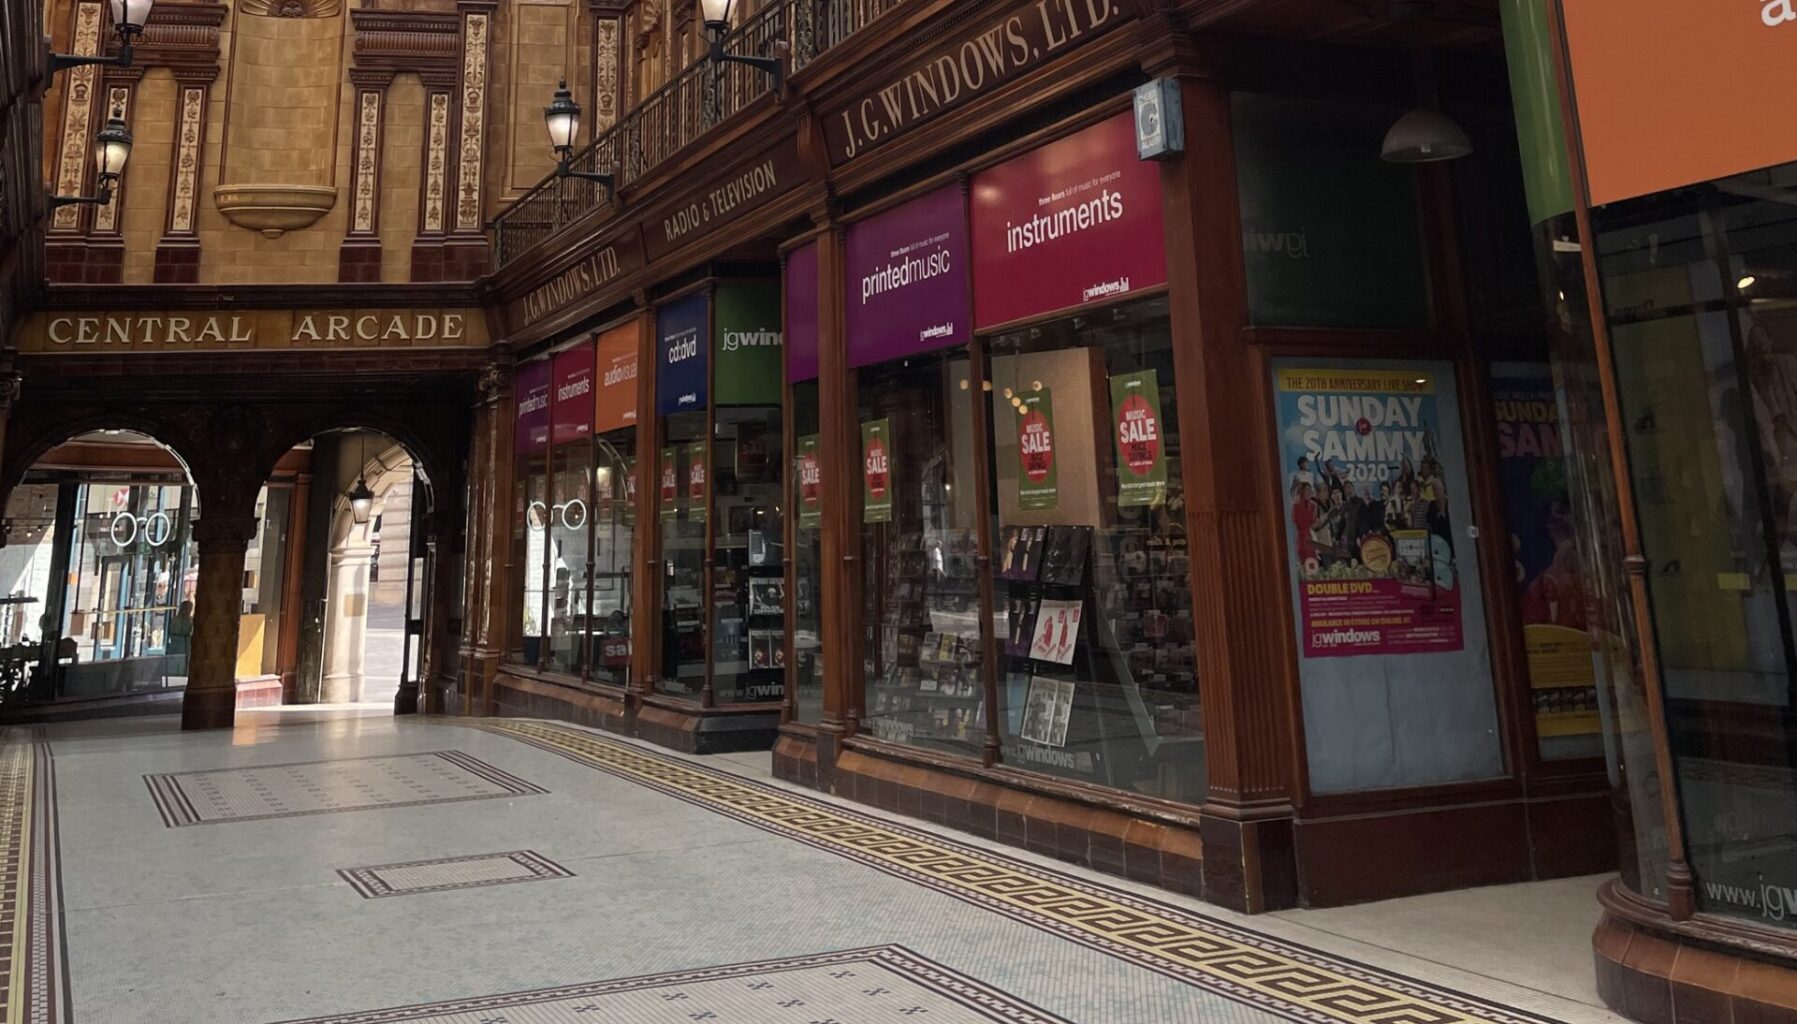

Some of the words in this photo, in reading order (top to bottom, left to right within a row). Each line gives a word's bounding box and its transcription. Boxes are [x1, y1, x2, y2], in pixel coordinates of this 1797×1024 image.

[664, 206, 700, 242] RADIO
[703, 202, 710, 222] &
[709, 159, 776, 217] TELEVISION
[1007, 189, 1123, 254] instruments
[862, 245, 950, 305] printedmusic
[47, 316, 252, 344] CENTRAL
[291, 314, 464, 341] ARCADE
[669, 334, 697, 364] cd:dvd
[558, 376, 590, 402] instruments
[1286, 376, 1302, 389] THE
[1304, 376, 1328, 390] 20TH
[1329, 377, 1382, 390] ANNIVERSARY
[1383, 378, 1402, 390] LIVE
[1297, 394, 1423, 428] SUNDAY
[1021, 432, 1051, 455] SALE
[1120, 418, 1157, 444] SALE
[1303, 429, 1426, 462] SAMMY
[802, 468, 820, 485] SALE
[866, 456, 888, 475] SALE
[1347, 462, 1389, 483] 2020
[1307, 583, 1349, 595] DOUBLE
[1312, 629, 1381, 648] jgwindows
